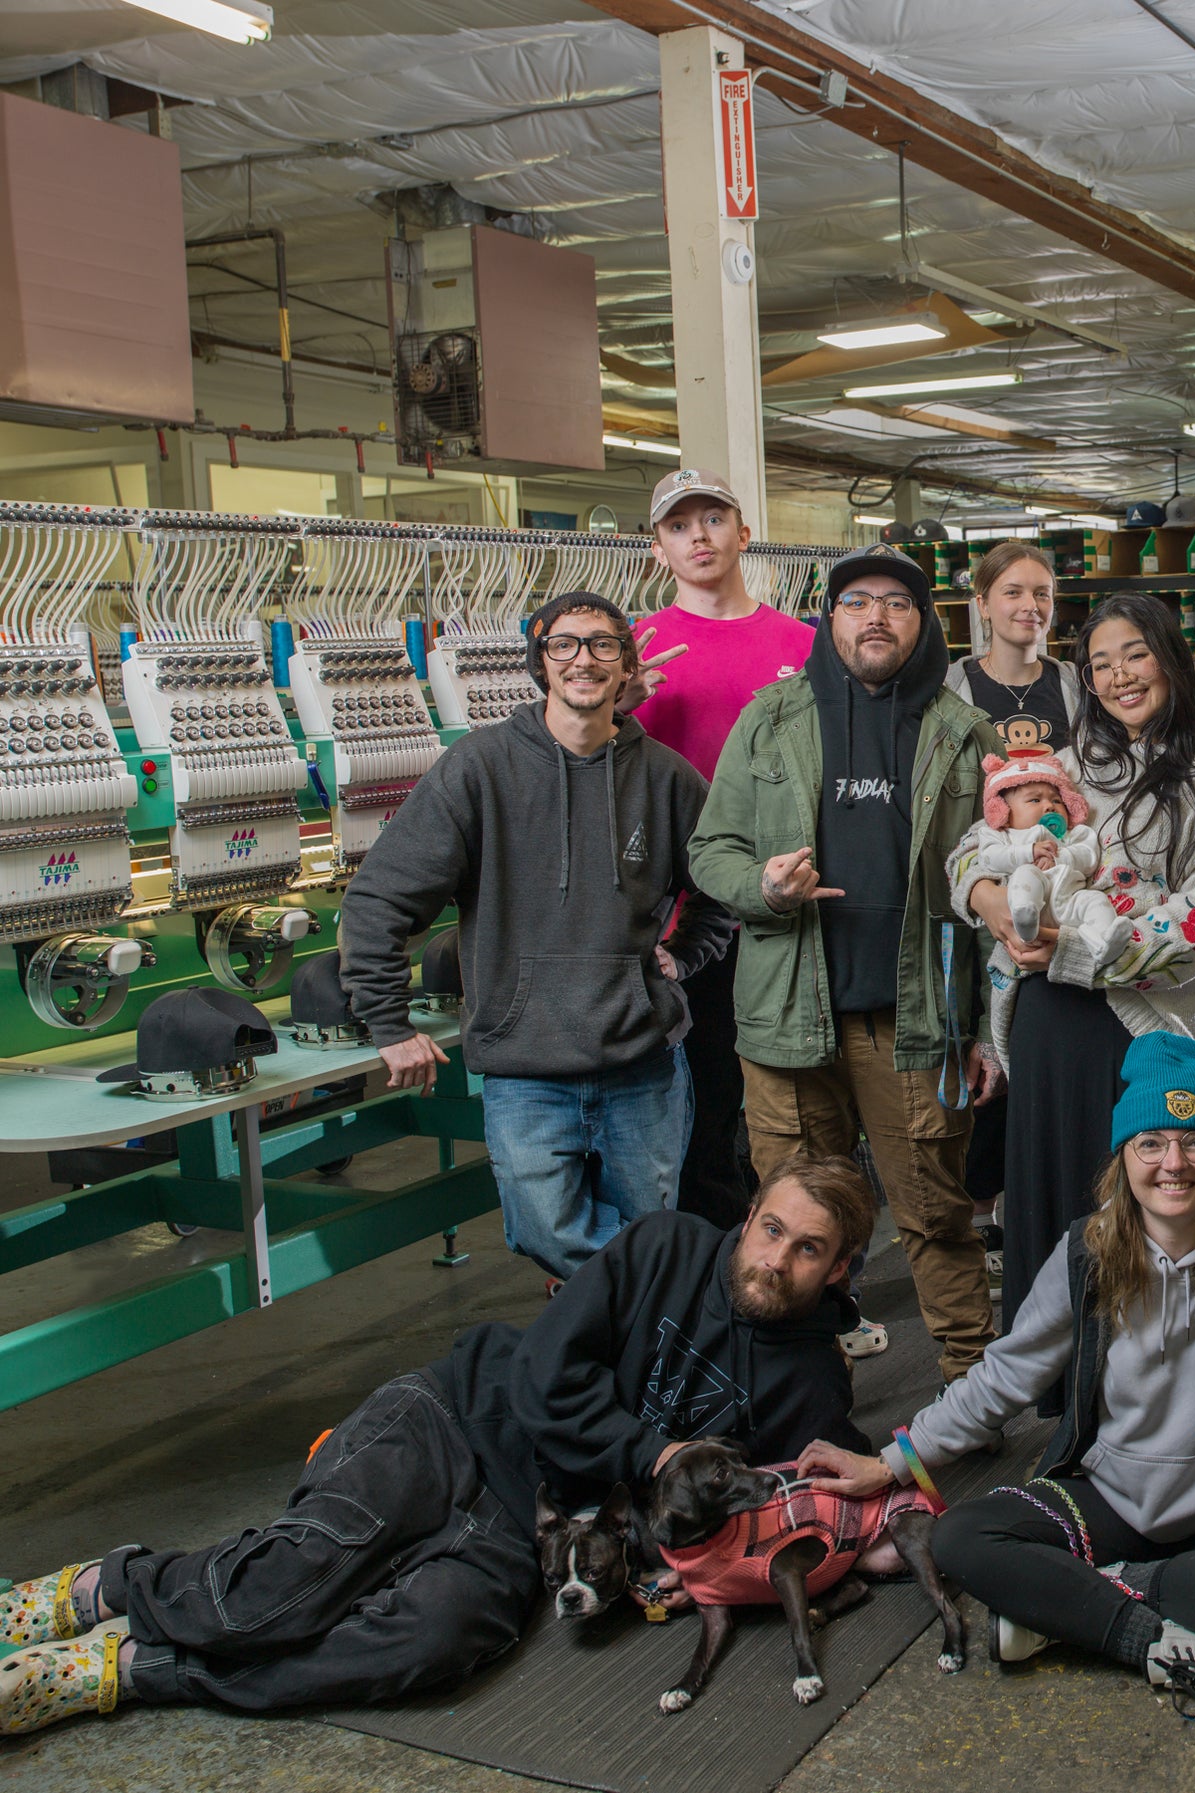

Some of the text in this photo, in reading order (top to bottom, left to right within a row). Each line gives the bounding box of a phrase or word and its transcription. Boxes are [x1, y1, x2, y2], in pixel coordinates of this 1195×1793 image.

[724, 84, 746, 99] FIRE
[732, 101, 744, 201] EXTINGUISHER
[225, 838, 258, 850] TAJIMA
[40, 863, 79, 876] TAJIMA
